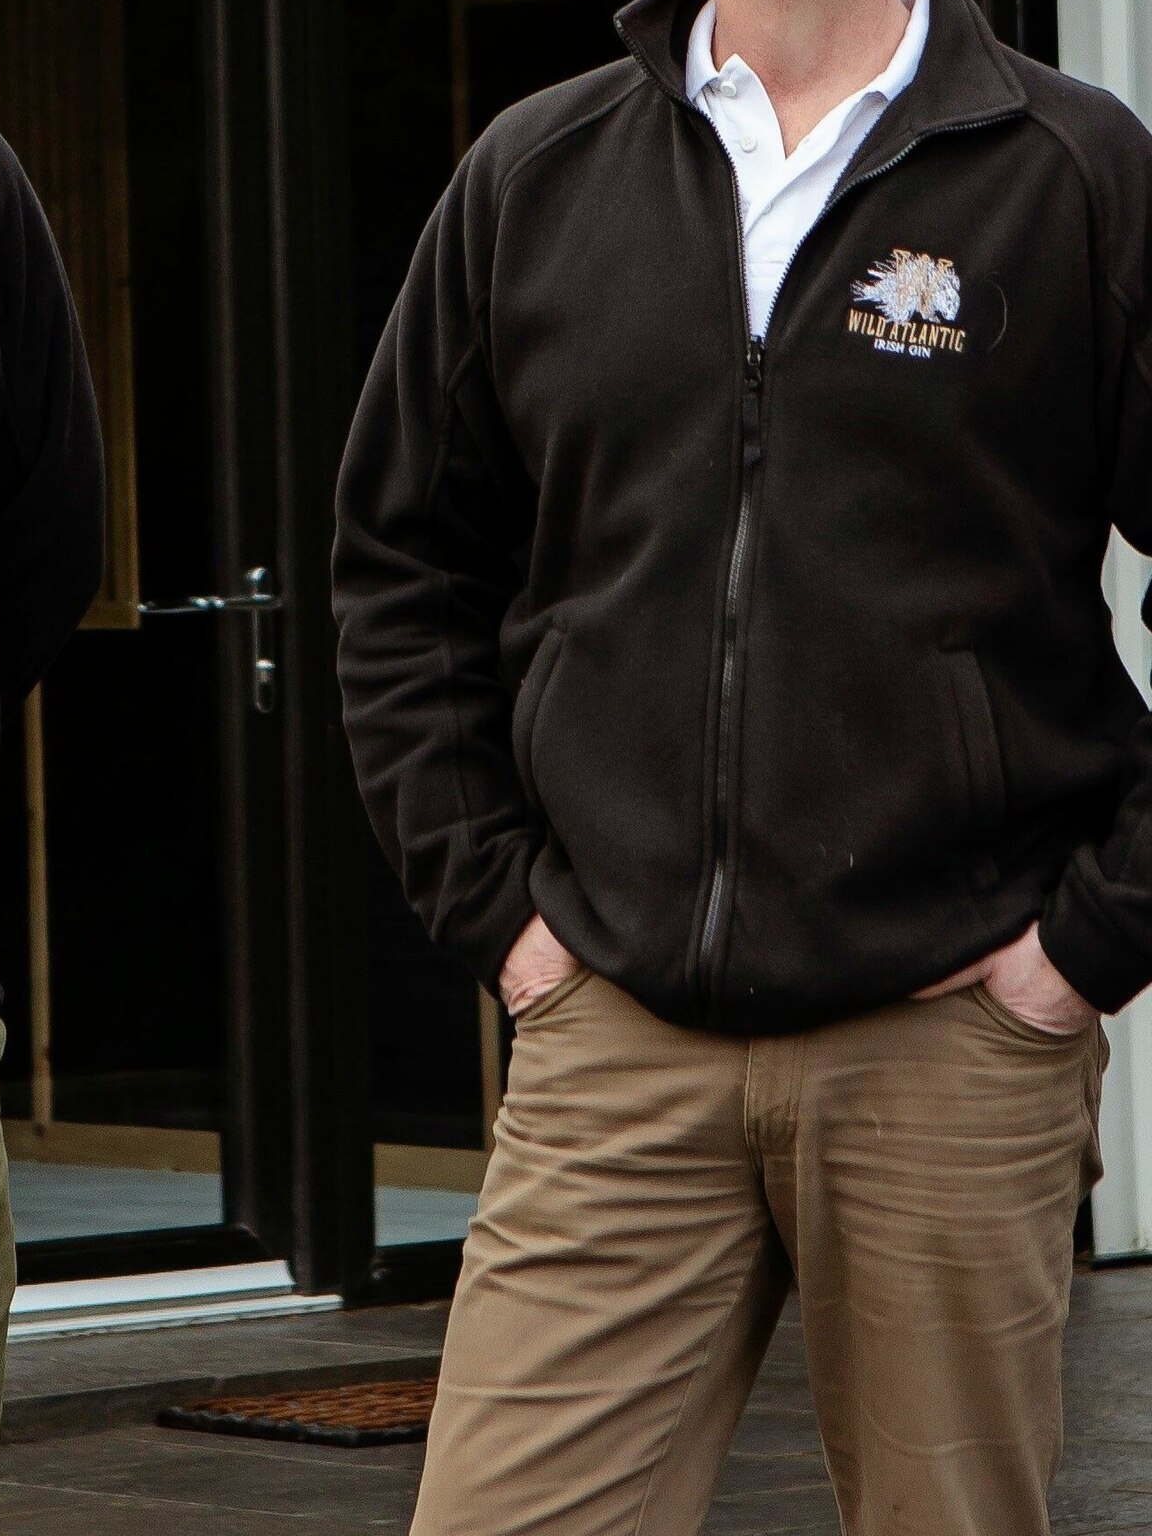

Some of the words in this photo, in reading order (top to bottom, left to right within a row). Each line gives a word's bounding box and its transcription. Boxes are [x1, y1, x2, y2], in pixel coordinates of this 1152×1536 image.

[848, 308, 887, 338] WILD
[889, 321, 966, 353] ATLANTIC
[873, 337, 905, 354] IRISH
[908, 343, 931, 359] GIN
